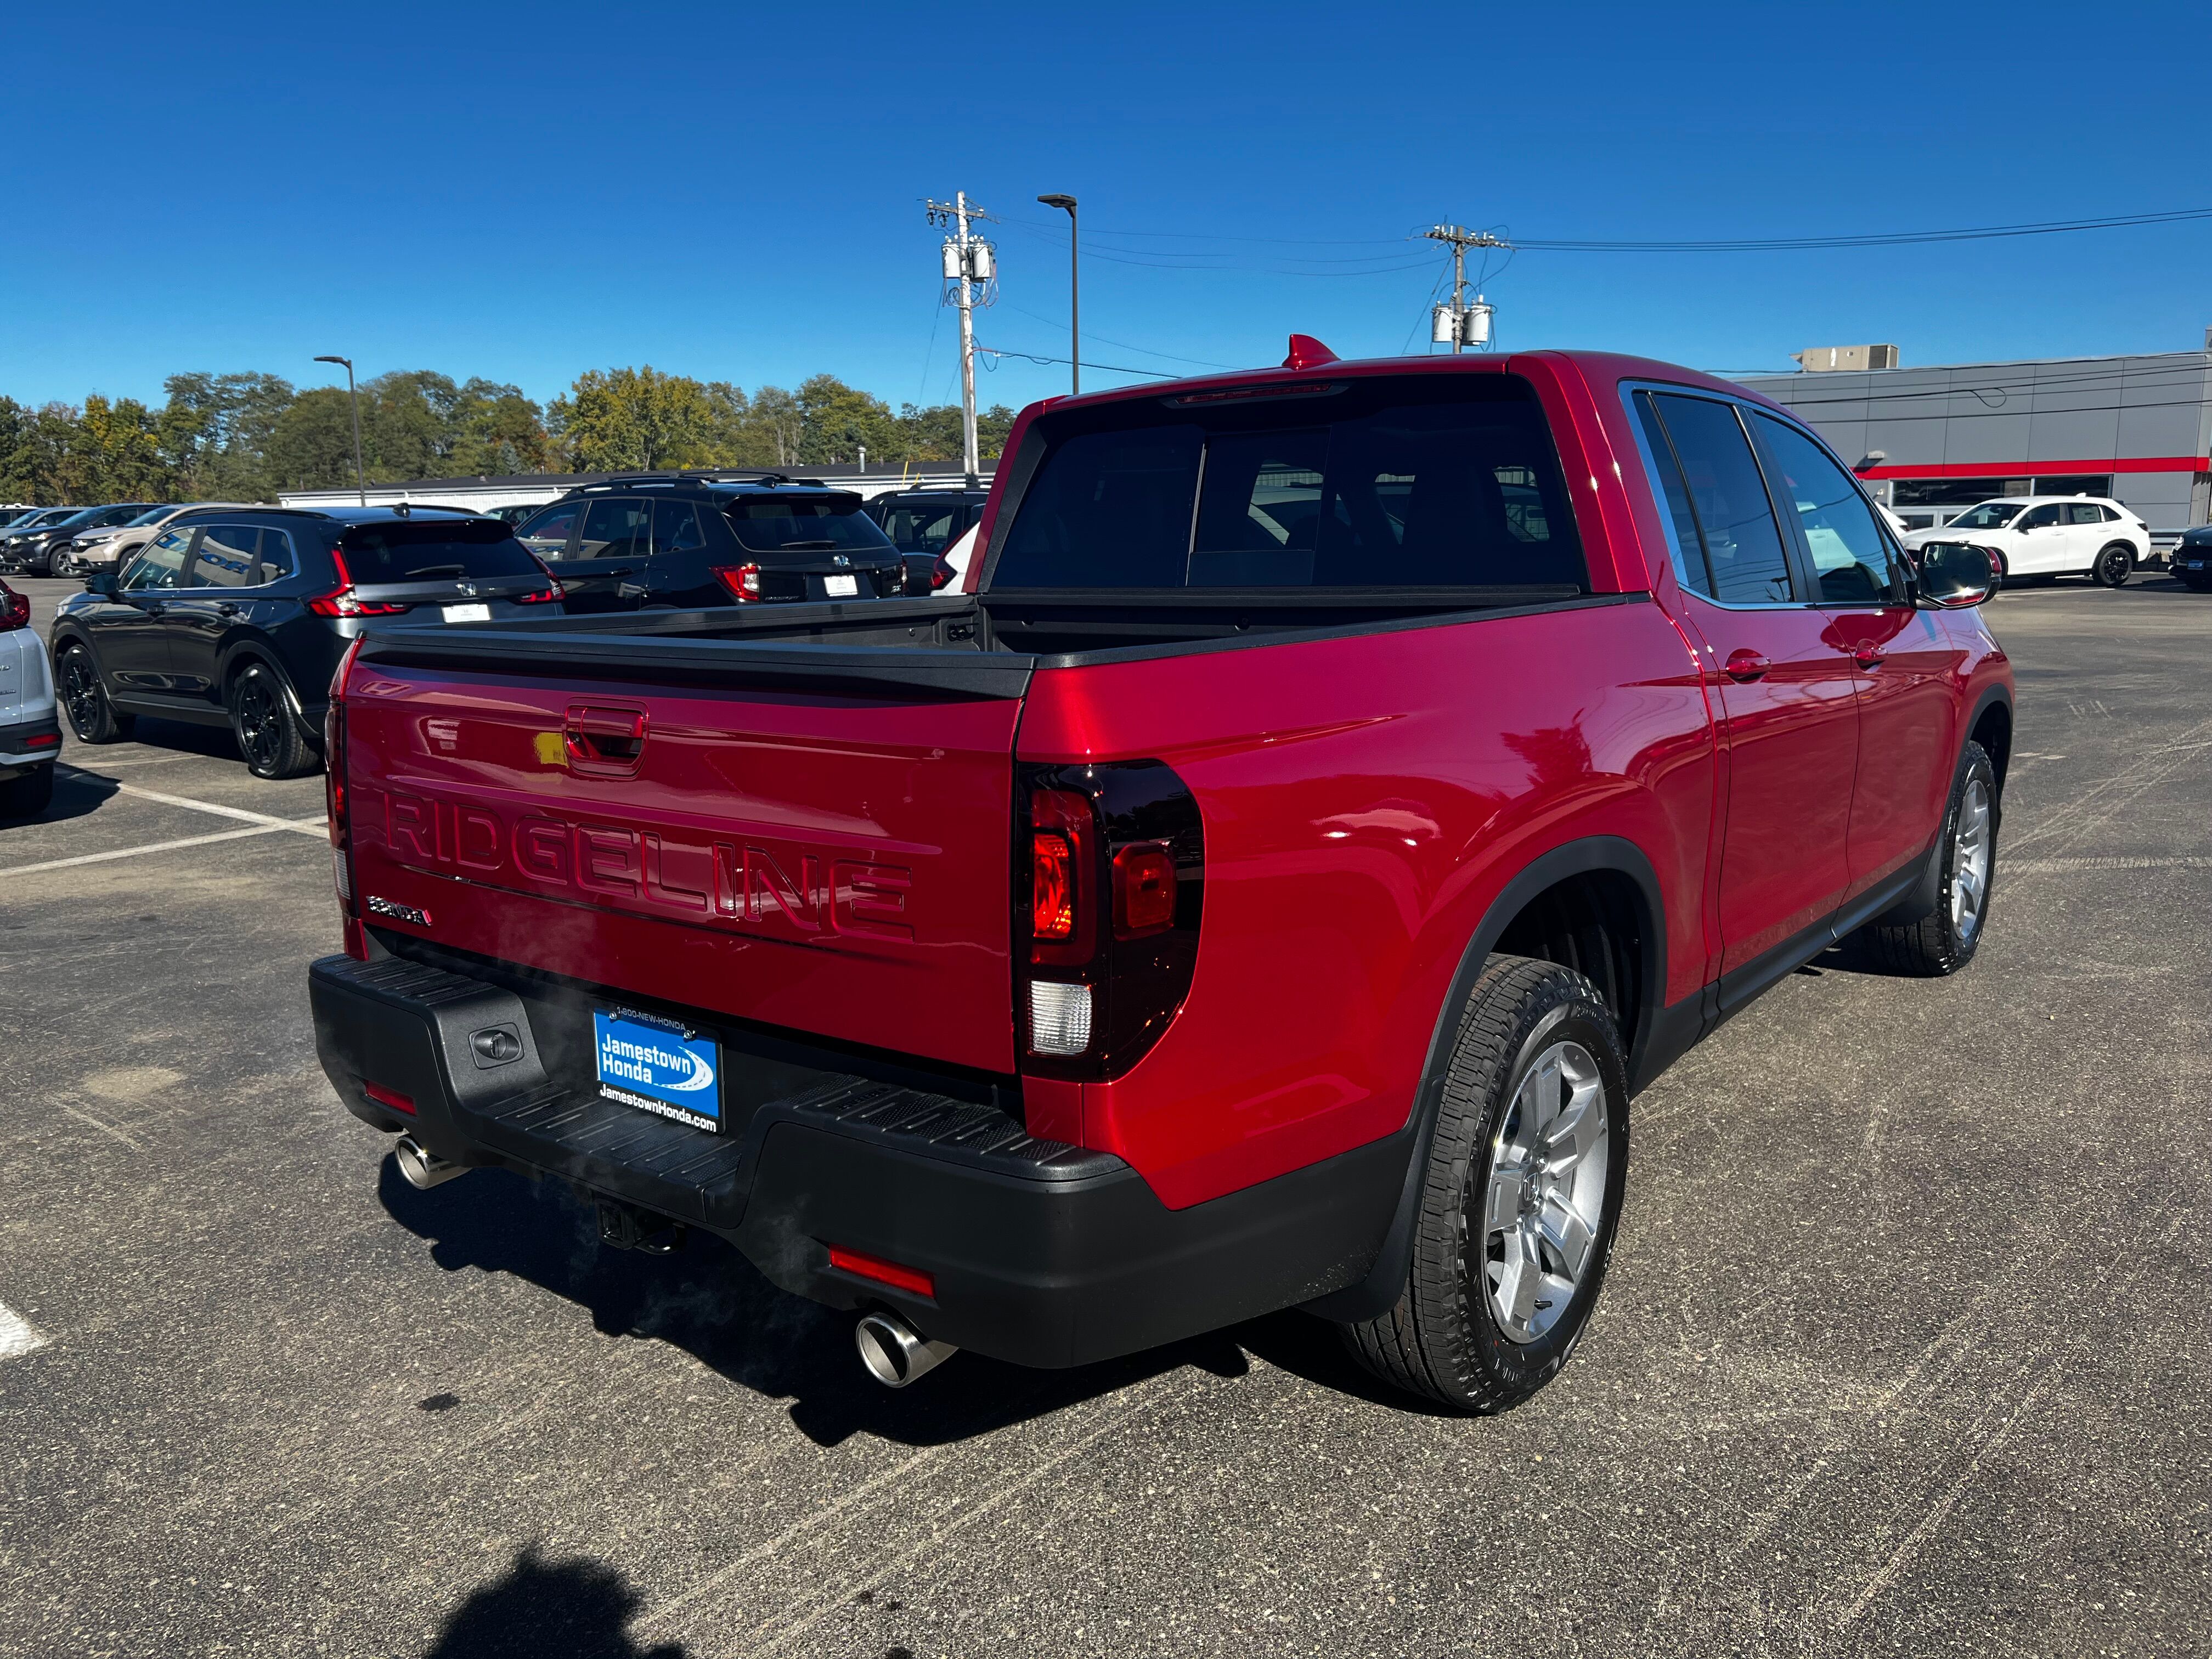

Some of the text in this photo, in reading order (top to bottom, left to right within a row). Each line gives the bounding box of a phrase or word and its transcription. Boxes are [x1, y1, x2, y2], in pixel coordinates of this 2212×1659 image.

[383, 791, 915, 944] RIDGELINE
[366, 895, 432, 927] HONDA
[602, 1034, 691, 1075] Jamestown
[602, 1052, 653, 1085] Honda
[600, 1084, 716, 1133] JamestownHonda.com
